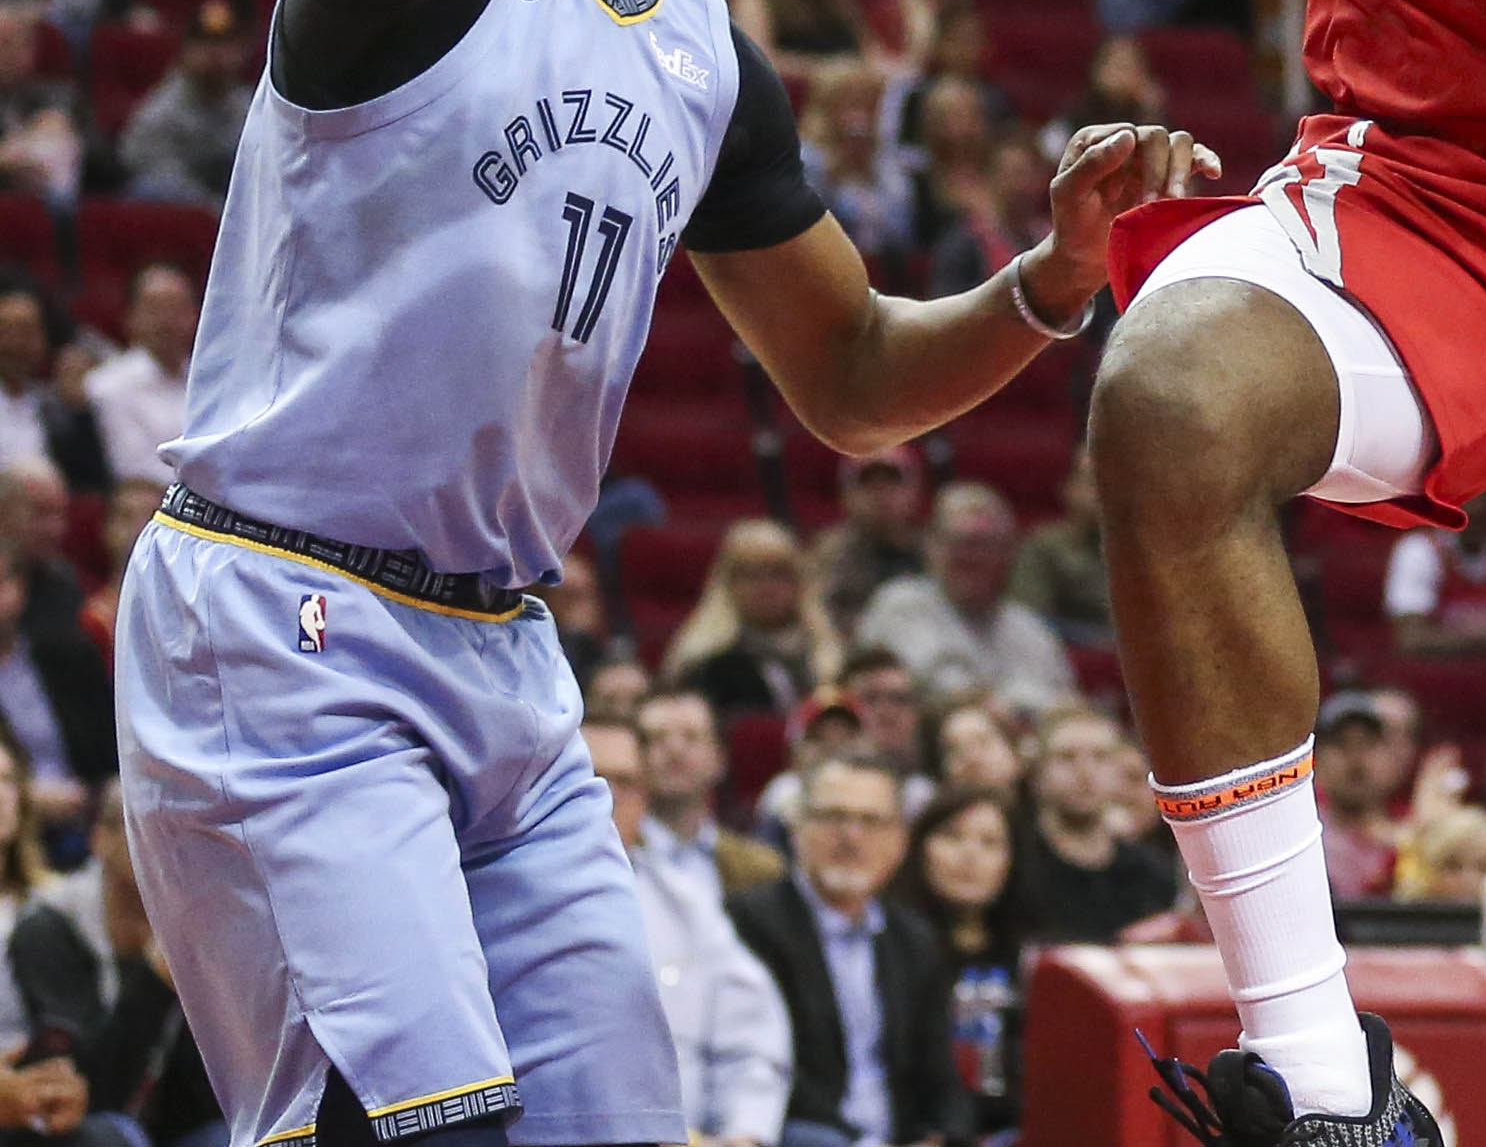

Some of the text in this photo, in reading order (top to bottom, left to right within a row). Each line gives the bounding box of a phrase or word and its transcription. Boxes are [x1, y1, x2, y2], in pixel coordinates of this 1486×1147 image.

[472, 89, 680, 275] GRIZZLIES
[551, 191, 634, 344] 11
[1155, 767, 1298, 814] NBA AUT
